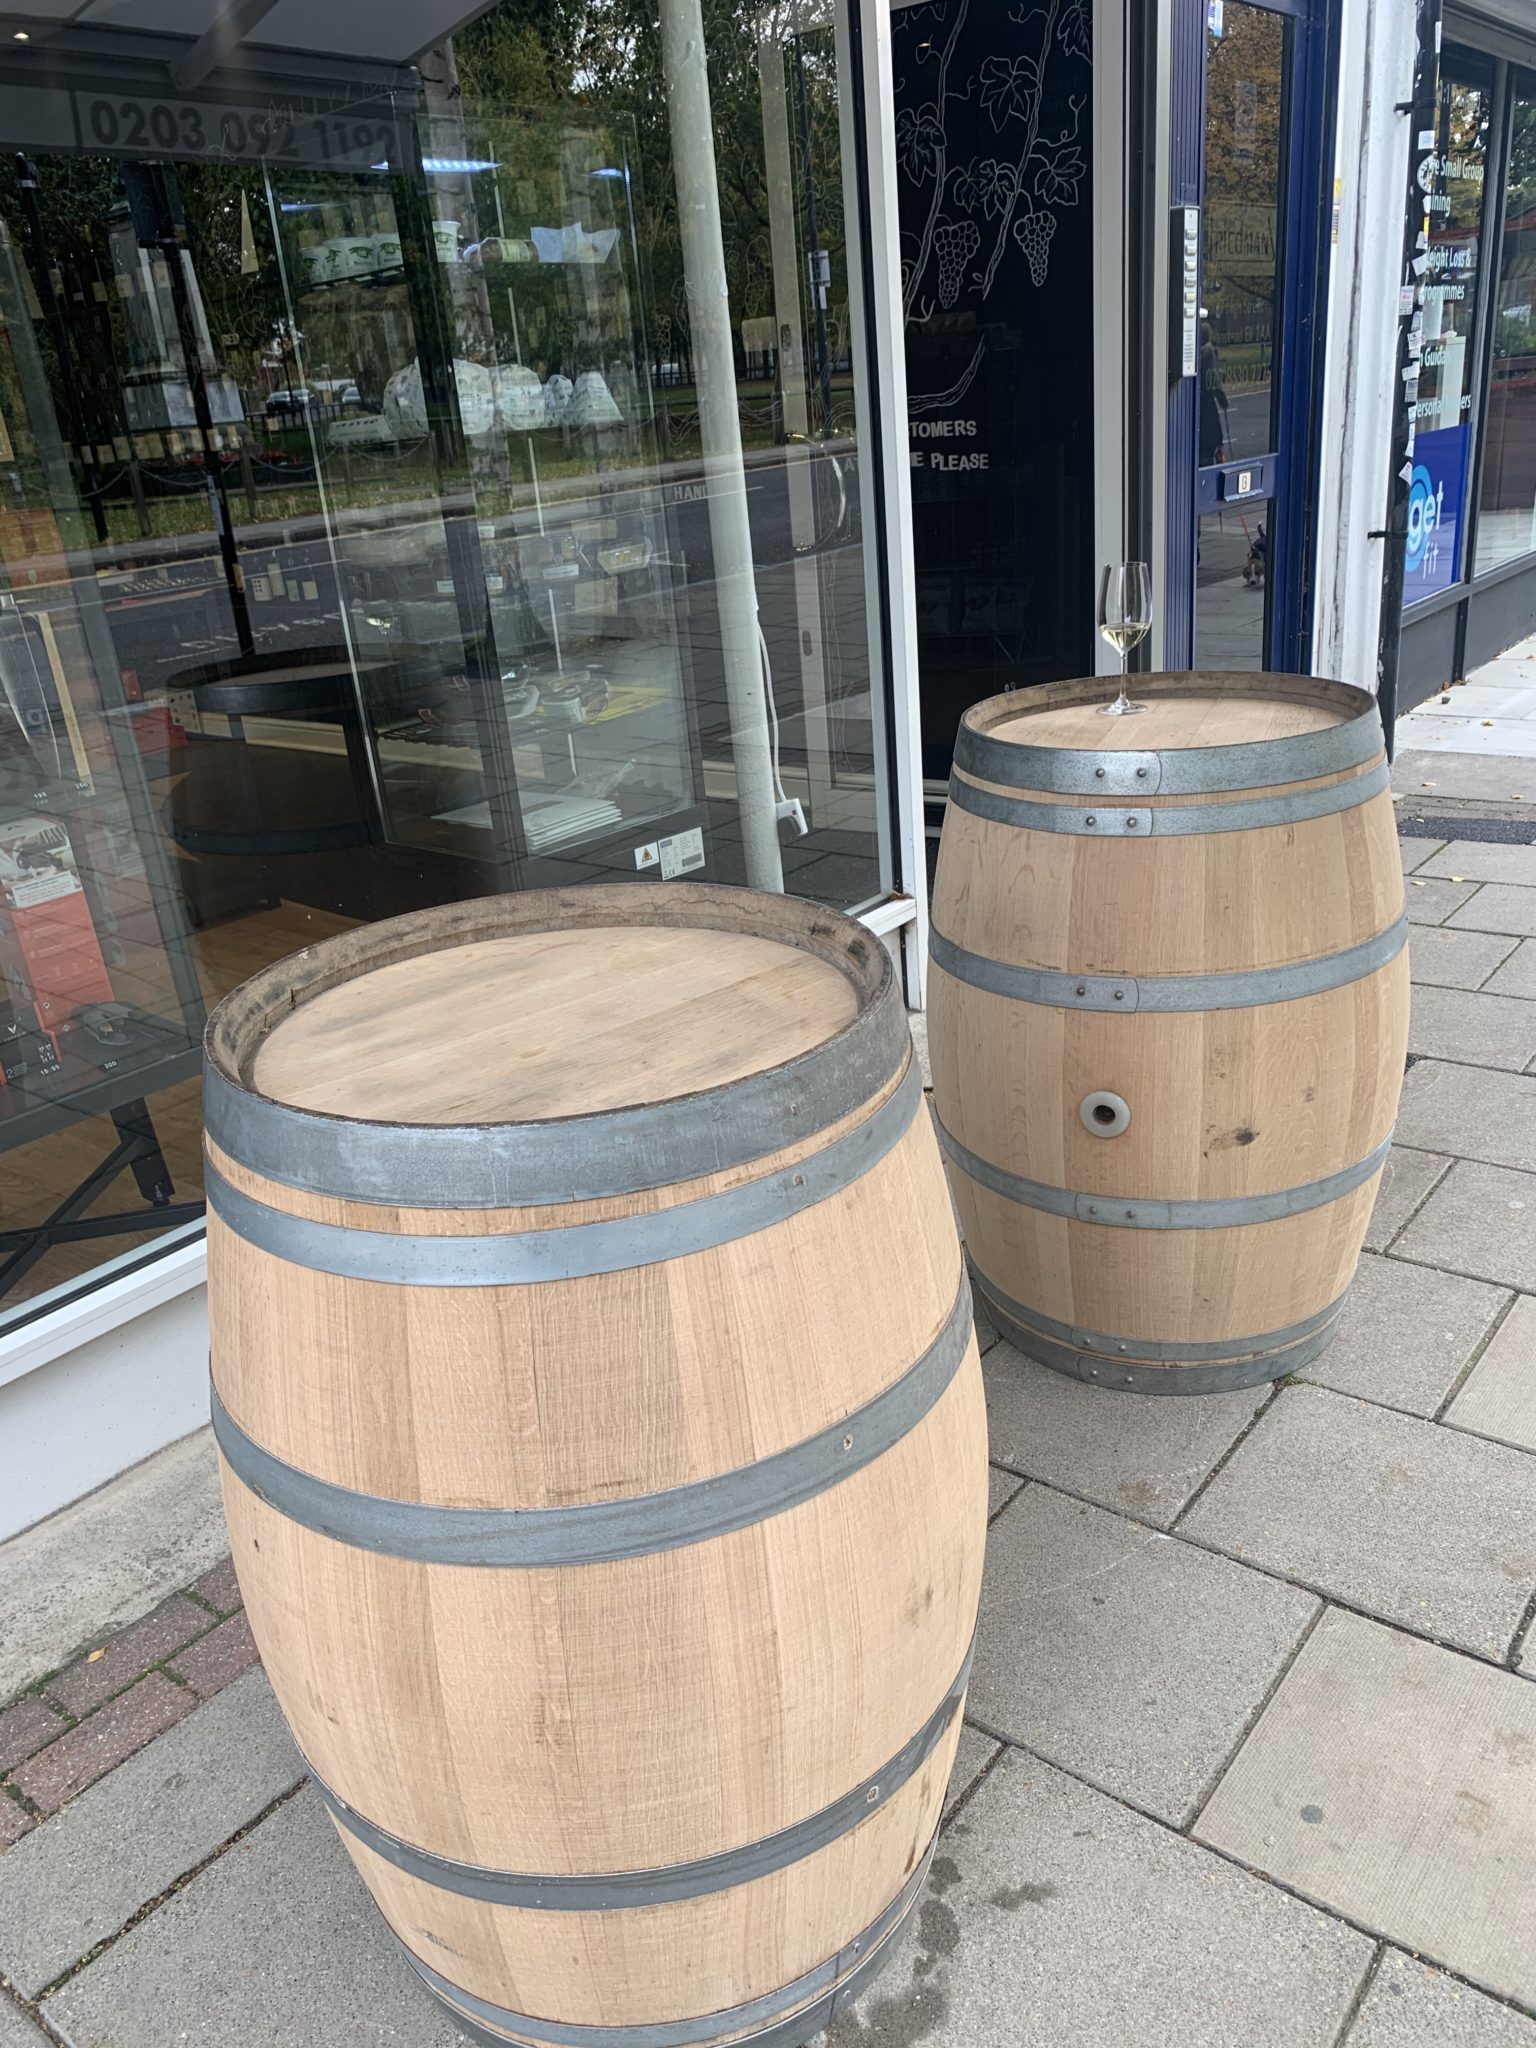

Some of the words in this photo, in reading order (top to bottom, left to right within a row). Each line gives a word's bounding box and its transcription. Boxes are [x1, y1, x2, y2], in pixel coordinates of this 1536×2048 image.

[90, 99, 205, 151] 0203
[219, 111, 299, 157] 092
[314, 119, 395, 165] 1192
[1441, 155, 1461, 178] Small
[1463, 159, 1484, 186] Group
[1431, 189, 1451, 217] ining
[1450, 247, 1464, 267] Loss
[1424, 285, 1464, 306] rogrammes
[931, 453, 989, 471] PLEASE
[1408, 480, 1443, 553] get
[1423, 541, 1438, 579] fit
